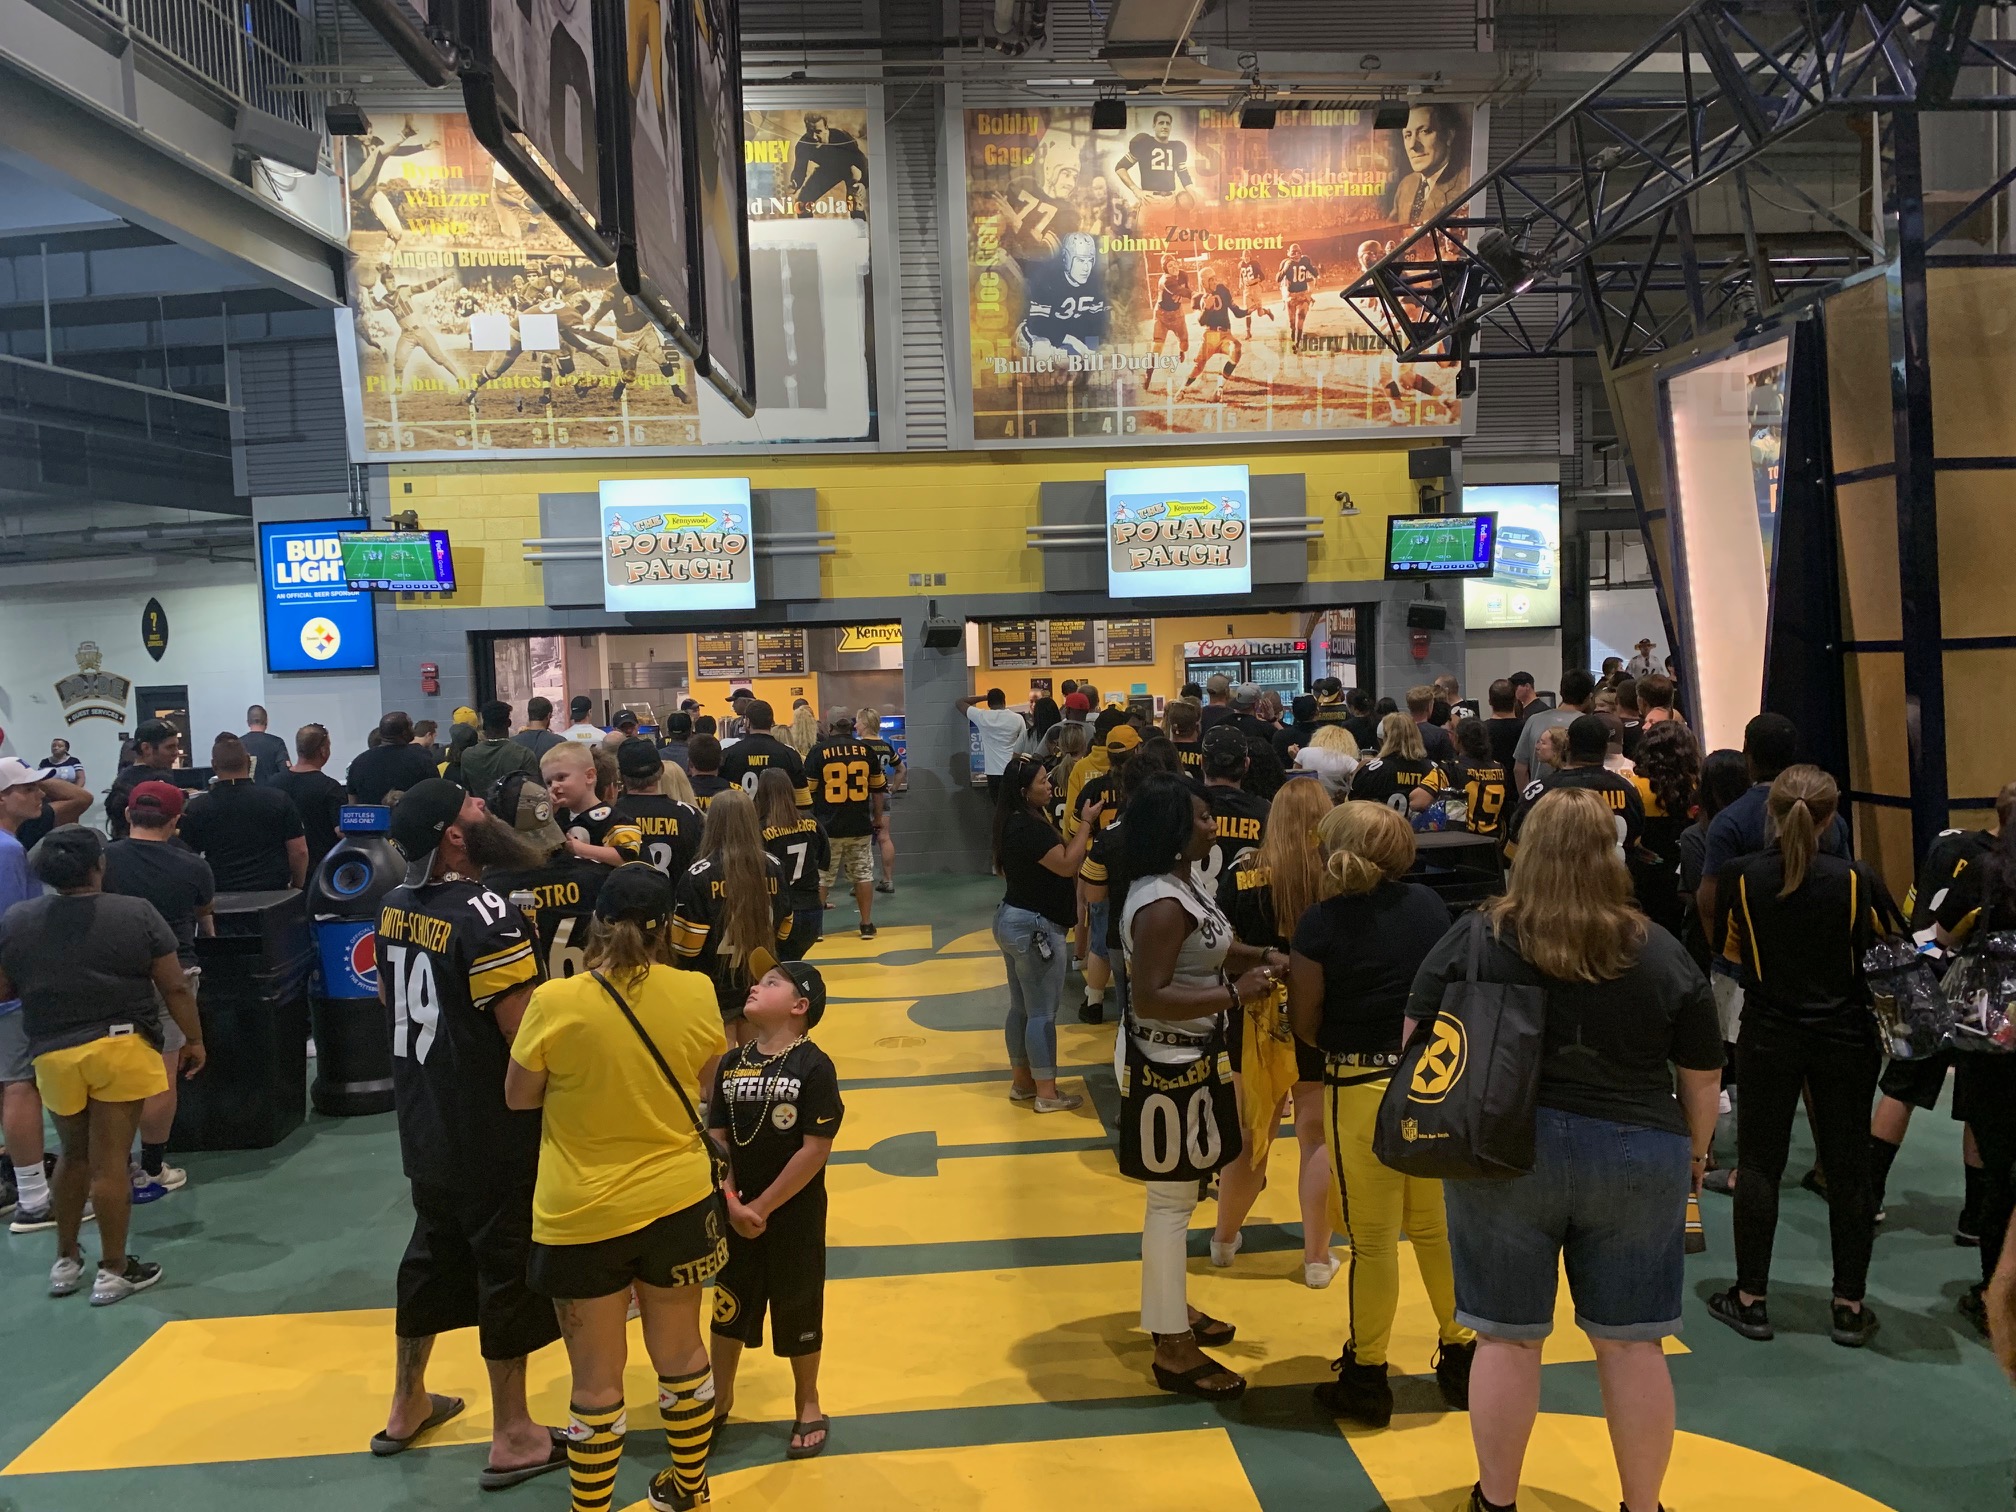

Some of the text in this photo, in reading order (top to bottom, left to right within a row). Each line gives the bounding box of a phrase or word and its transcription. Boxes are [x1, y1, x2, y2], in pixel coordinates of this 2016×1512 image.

[978, 113, 1038, 137] Bobby
[984, 144, 1035, 168] Gage
[1151, 148, 1174, 171] 21
[401, 161, 464, 185] Byron
[403, 189, 490, 209] Whizzer
[1222, 178, 1386, 202] Jock Sutherland
[769, 194, 855, 216] Niccolai
[406, 217, 469, 236] White
[1164, 225, 1210, 243] Zero
[1099, 231, 1284, 256] Johnny Clement
[392, 249, 455, 270] Angelo
[1299, 332, 1340, 352] Jerry
[985, 351, 1181, 375] "Bullet" Bill Dudley
[1101, 416, 1137, 434] 4 3
[1136, 501, 1166, 519] THE
[1173, 504, 1209, 513] Kennywood
[633, 514, 664, 532] THE
[672, 517, 709, 527] Kennywood
[1113, 517, 1245, 545] POTATO
[286, 538, 342, 562] BUD
[608, 531, 747, 558] POTATO
[1128, 543, 1231, 571] PATCH
[625, 557, 734, 584] PATCH
[1197, 640, 1248, 658] Coors
[1249, 642, 1292, 655] LIGHT
[71, 708, 119, 721] GUEST SERVICES
[748, 755, 770, 767] WATT
[823, 745, 868, 760] MILLER
[822, 761, 870, 804] 83
[1397, 771, 1423, 786] WATT
[1464, 781, 1506, 834] 19
[786, 841, 808, 887] 7
[467, 890, 508, 926] 19
[378, 904, 452, 954] SMITH-SCHUSTER
[386, 944, 440, 1066] 19
[1142, 1055, 1211, 1093] STEELERS
[722, 1076, 802, 1104] STEELERS
[1140, 1086, 1222, 1173] 00
[1404, 1128, 1417, 1139] NFL
